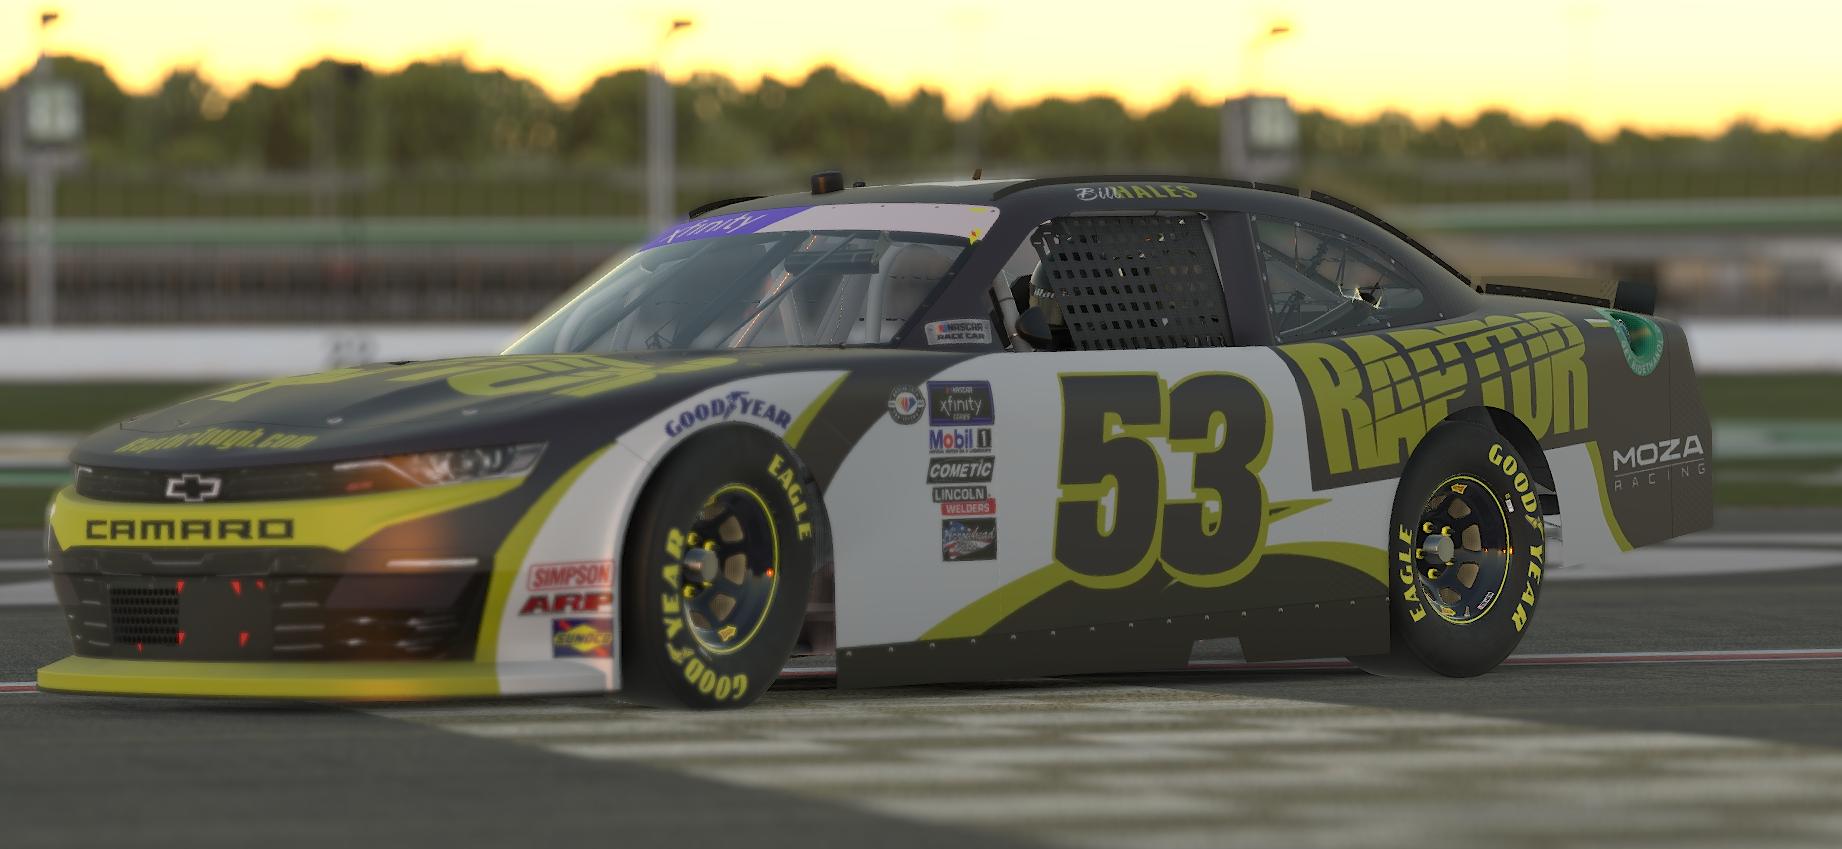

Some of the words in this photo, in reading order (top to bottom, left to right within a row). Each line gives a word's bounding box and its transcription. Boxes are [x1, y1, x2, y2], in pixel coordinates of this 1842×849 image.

[1075, 185, 1121, 201] Bill
[1116, 184, 1198, 199] HALES
[659, 213, 769, 244] xfinity
[947, 322, 984, 332] NASCAR
[965, 333, 986, 341] CAR
[1276, 311, 1589, 475] RAPTOR
[940, 395, 982, 417] xfinity
[929, 428, 973, 449] Mobil
[1613, 434, 1704, 472] MOZA
[929, 459, 992, 479] COMETIC
[1053, 371, 1273, 590] 53
[1614, 463, 1706, 492] RACING
[768, 453, 813, 542] EAGLE
[935, 488, 984, 500] LINCOLN
[946, 503, 990, 514] WELDERS
[86, 518, 294, 540] CAMARO
[533, 563, 609, 588] SIMPSON
[1398, 523, 1428, 623] EAGLE
[518, 591, 614, 616] ARP
